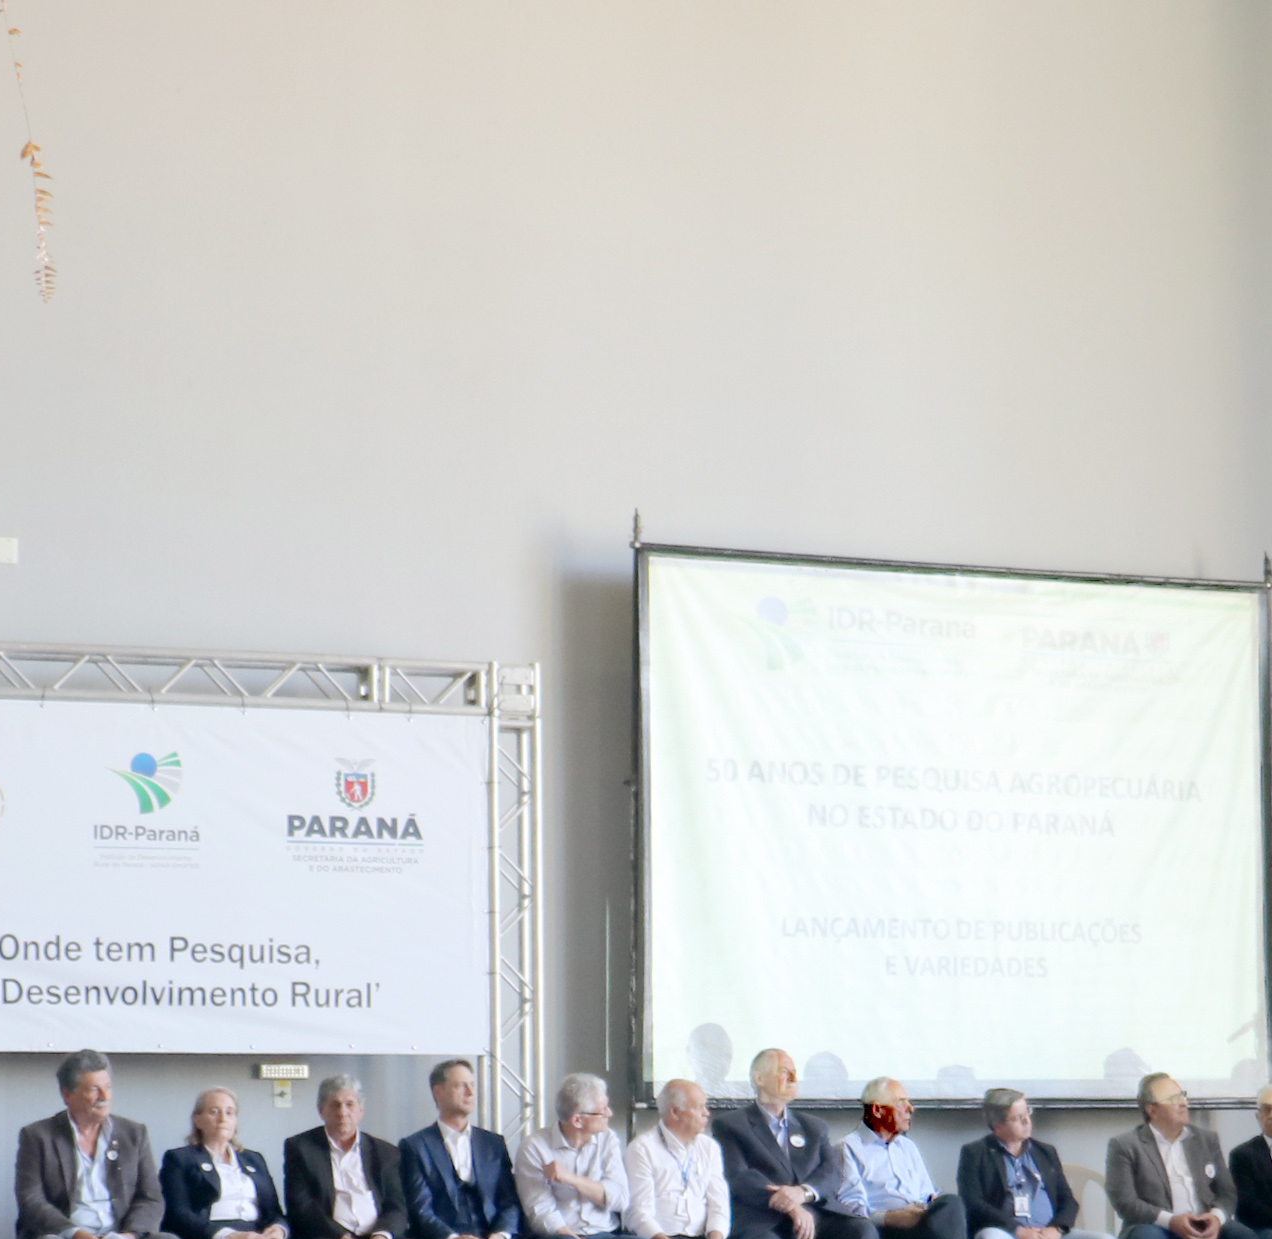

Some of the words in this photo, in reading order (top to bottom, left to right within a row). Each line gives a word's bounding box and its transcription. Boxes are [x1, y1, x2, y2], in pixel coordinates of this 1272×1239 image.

[706, 758, 738, 782] 50
[747, 760, 824, 786] ANOS
[832, 763, 866, 787] DE
[876, 765, 1002, 793] PESQUISA
[1009, 771, 1202, 803] AGROPECUÁRIA
[93, 824, 200, 842] IDR-Paraná
[286, 813, 424, 840] PARANÁ
[808, 803, 849, 827] NO
[858, 805, 958, 831] ESTADO
[966, 809, 1003, 833] DO
[1012, 809, 1117, 837] PARANÁ
[292, 855, 344, 863] SECRETARIA
[361, 856, 419, 865] AGRICULTURA
[309, 864, 314, 872] E
[332, 865, 403, 874] ABASTECIMENTO
[781, 916, 950, 943] LANÇAMENTO
[956, 919, 986, 940] DE
[992, 918, 1143, 948] PUBLICAÇÕES
[94, 936, 156, 963] tem
[169, 935, 321, 970] Pesquisa,
[885, 955, 897, 977] E
[904, 955, 1048, 978] VARIEDADES
[1, 978, 278, 1008] Desenvolvimento
